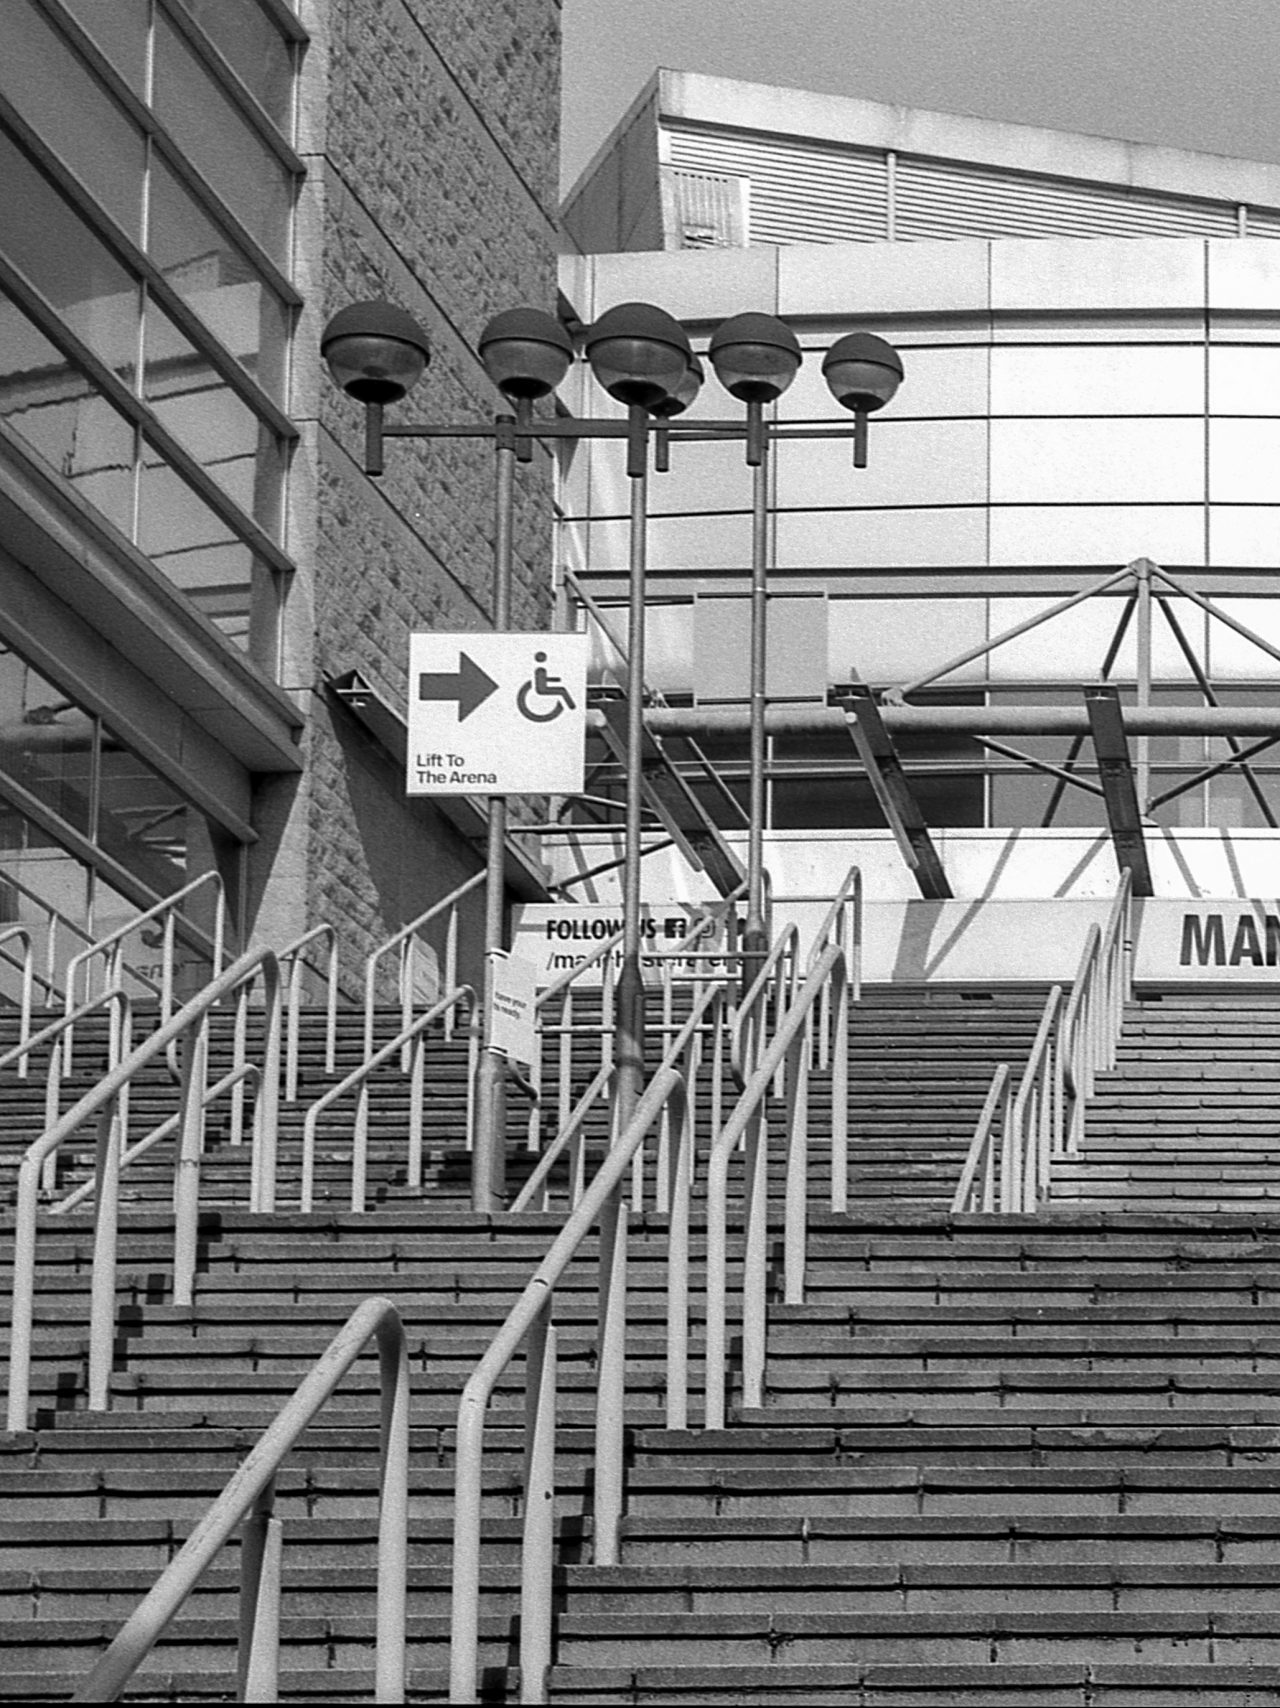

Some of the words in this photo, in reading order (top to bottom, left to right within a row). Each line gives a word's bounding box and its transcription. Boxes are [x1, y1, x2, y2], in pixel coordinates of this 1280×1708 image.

[416, 754, 442, 767] Lift
[446, 754, 465, 767] To
[416, 771, 446, 784] The
[449, 771, 497, 784] Arena
[547, 919, 627, 939] FOLLOW
